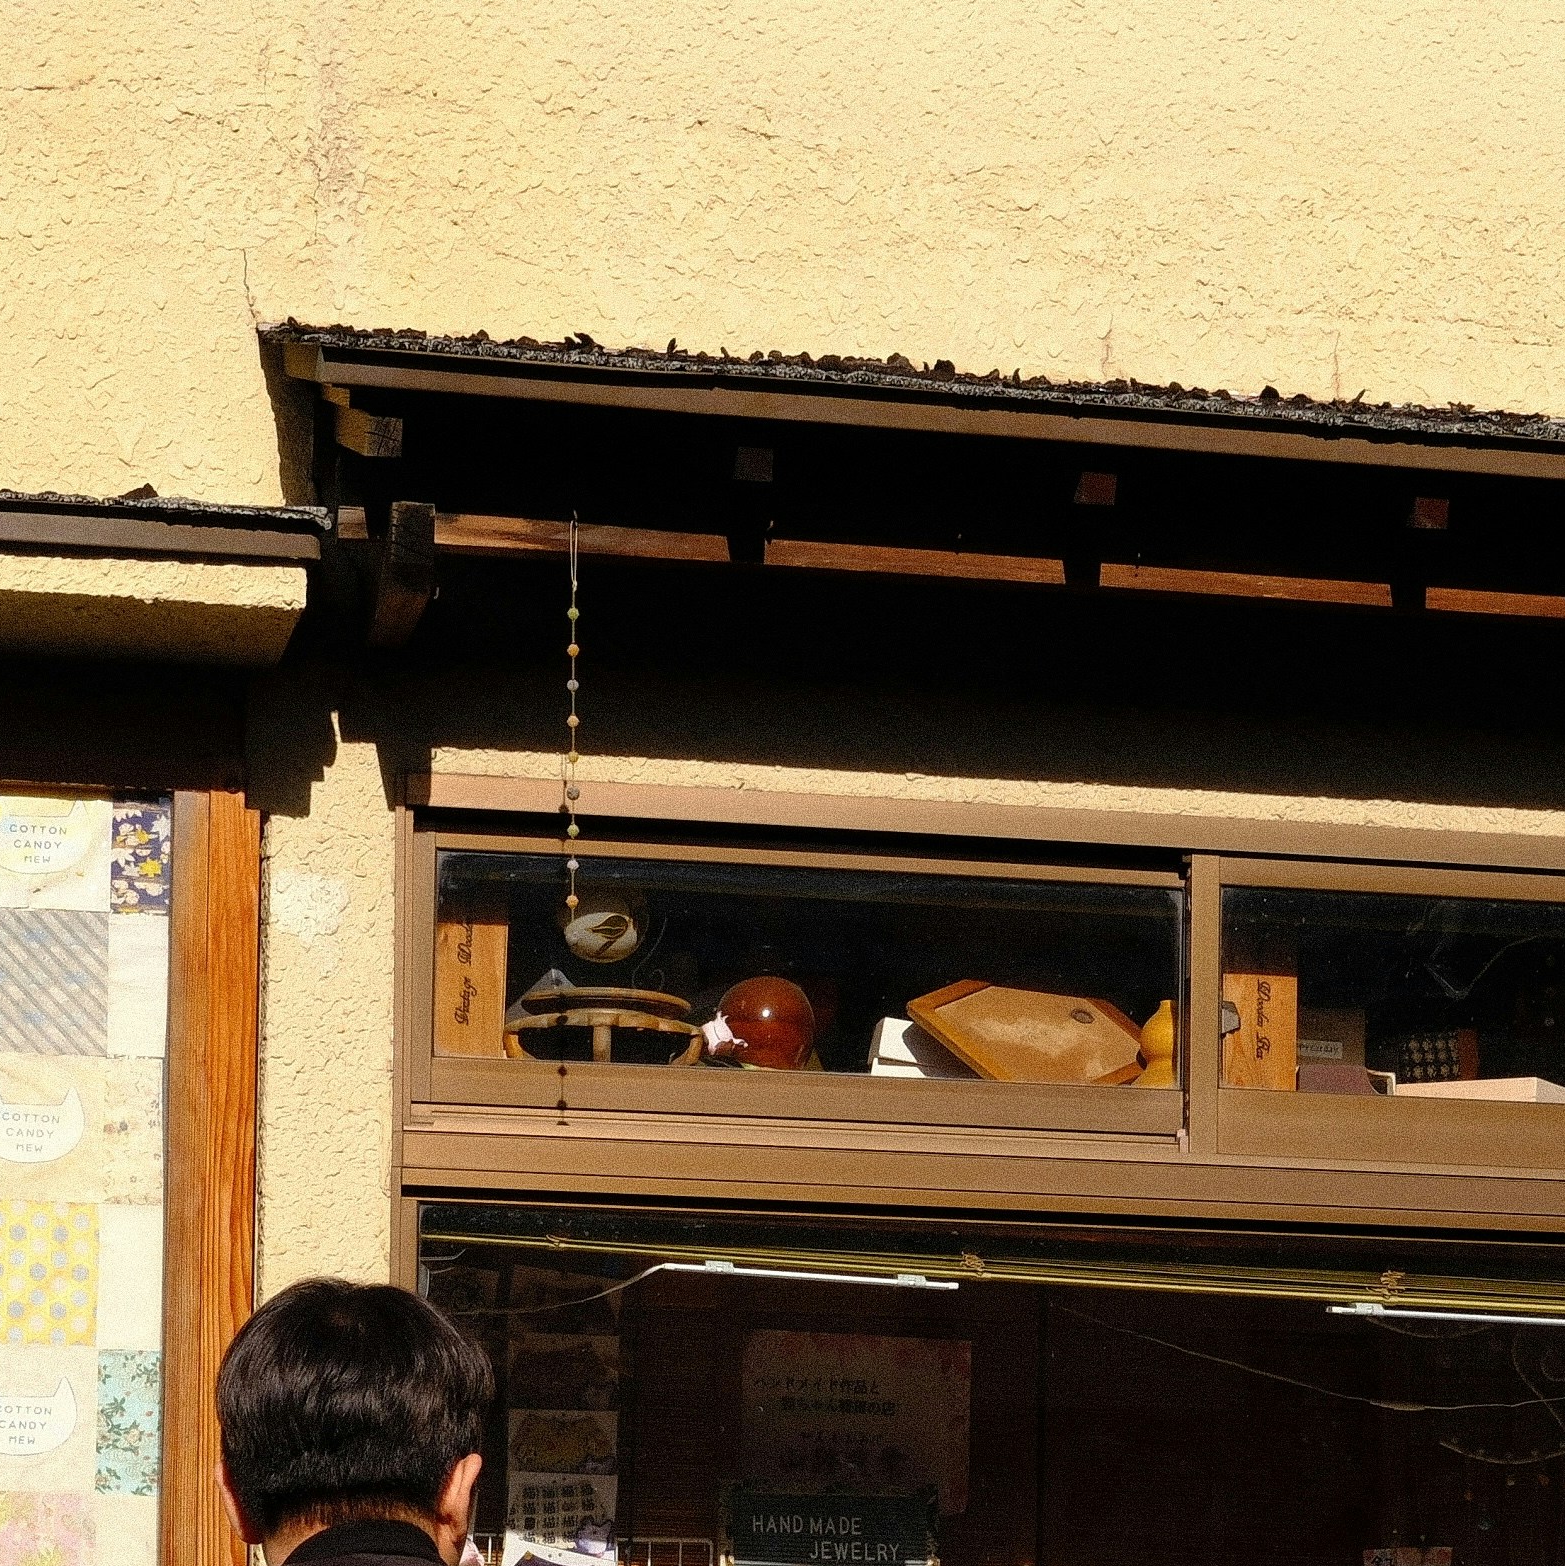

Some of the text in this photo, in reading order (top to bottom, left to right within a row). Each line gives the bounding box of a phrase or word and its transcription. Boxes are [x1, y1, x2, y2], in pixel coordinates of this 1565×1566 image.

[8, 823, 69, 837] COTTON
[12, 839, 63, 852] CANDY
[23, 854, 53, 865] MEW
[0, 1111, 62, 1125] COTTON
[5, 1126, 55, 1140] CANDY
[15, 1142, 46, 1153] MEW
[7, 1435, 38, 1446] MEW
[809, 1541, 900, 1562] JEWELRY
